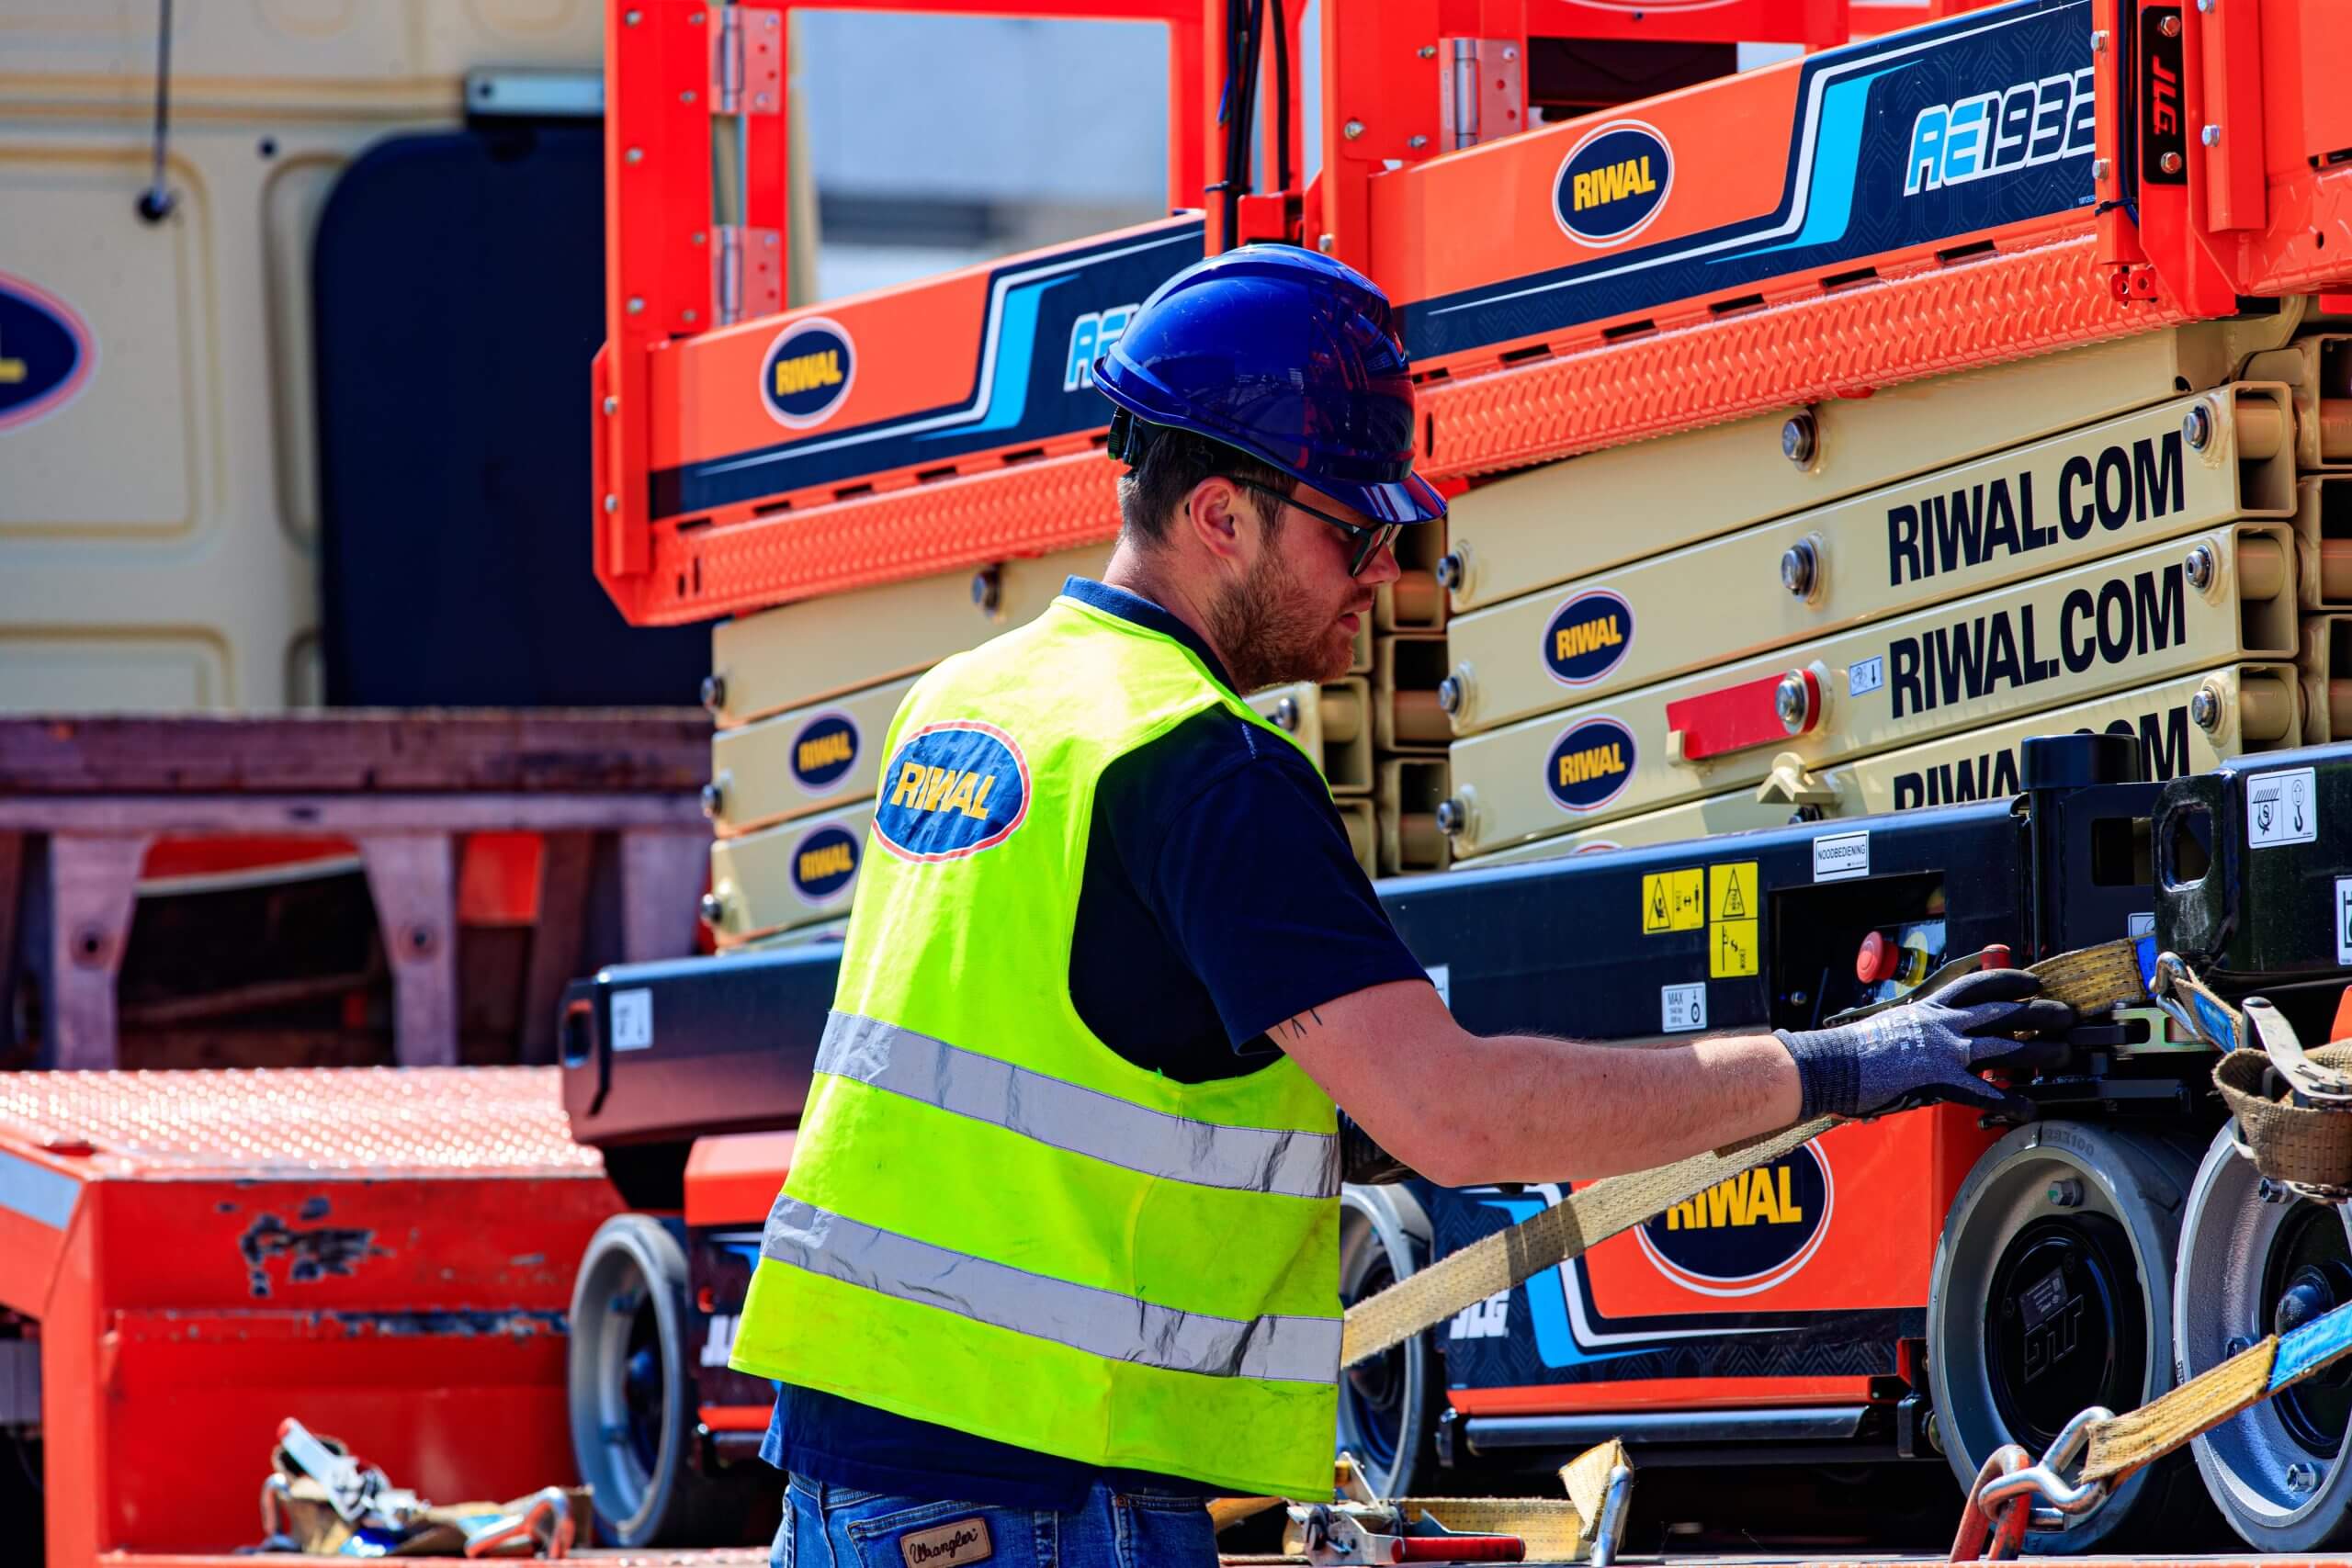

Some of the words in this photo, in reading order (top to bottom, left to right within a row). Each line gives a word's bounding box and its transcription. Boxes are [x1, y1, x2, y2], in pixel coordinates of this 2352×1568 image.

[2152, 54, 2177, 134] JLG
[1903, 66, 2096, 197] AE1932
[1573, 155, 1657, 211] RIWAL
[775, 349, 842, 397] RIWAL
[1887, 430, 2185, 587] RIWAL.COM
[1556, 615, 1623, 661] RIWAL
[1890, 563, 2187, 718] RIWAL.COM
[797, 729, 853, 773] RIWAL
[1559, 742, 1625, 787] RIWAL
[889, 761, 997, 820] RIWAL
[799, 841, 854, 883] RIWAL
[1817, 844, 1866, 861] NOODBEDIENING
[1668, 991, 1684, 1006] MAX
[909, 1528, 979, 1564] Wrangler
